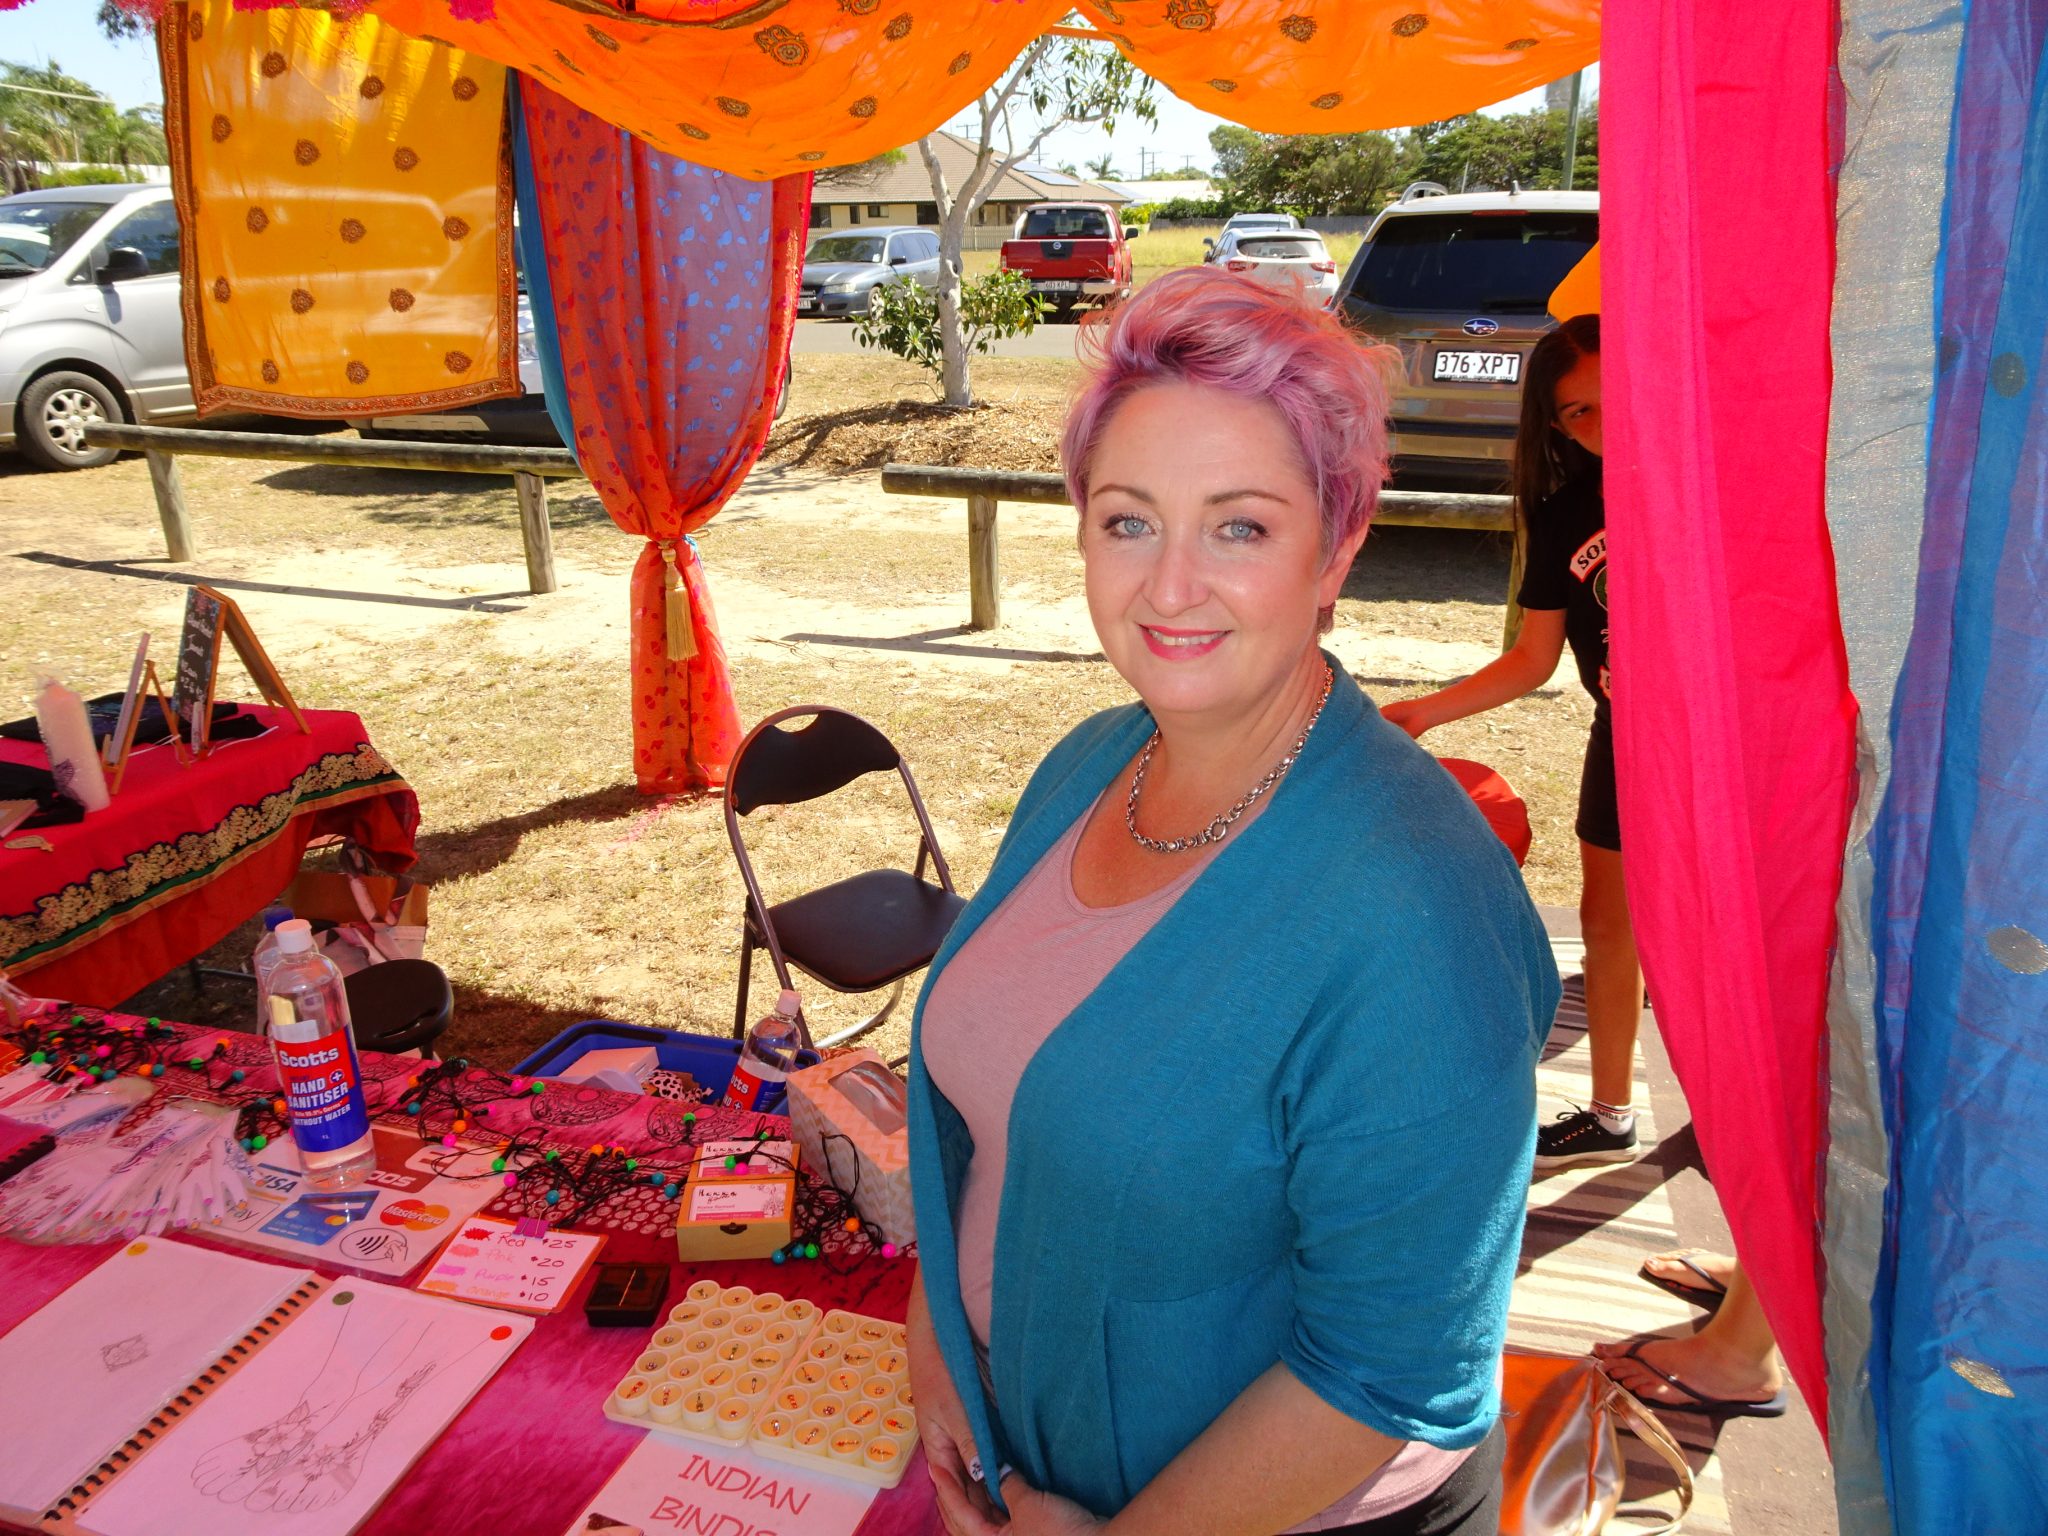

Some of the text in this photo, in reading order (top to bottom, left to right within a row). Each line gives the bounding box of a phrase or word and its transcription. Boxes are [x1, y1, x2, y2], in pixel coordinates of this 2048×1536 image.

[279, 1047, 339, 1067] Scotts
[292, 1078, 326, 1094] HAND
[325, 1104, 351, 1122] WATER
[383, 1205, 447, 1225] MasterCard
[497, 1231, 526, 1248] Red
[678, 1454, 812, 1516] INDIAN
